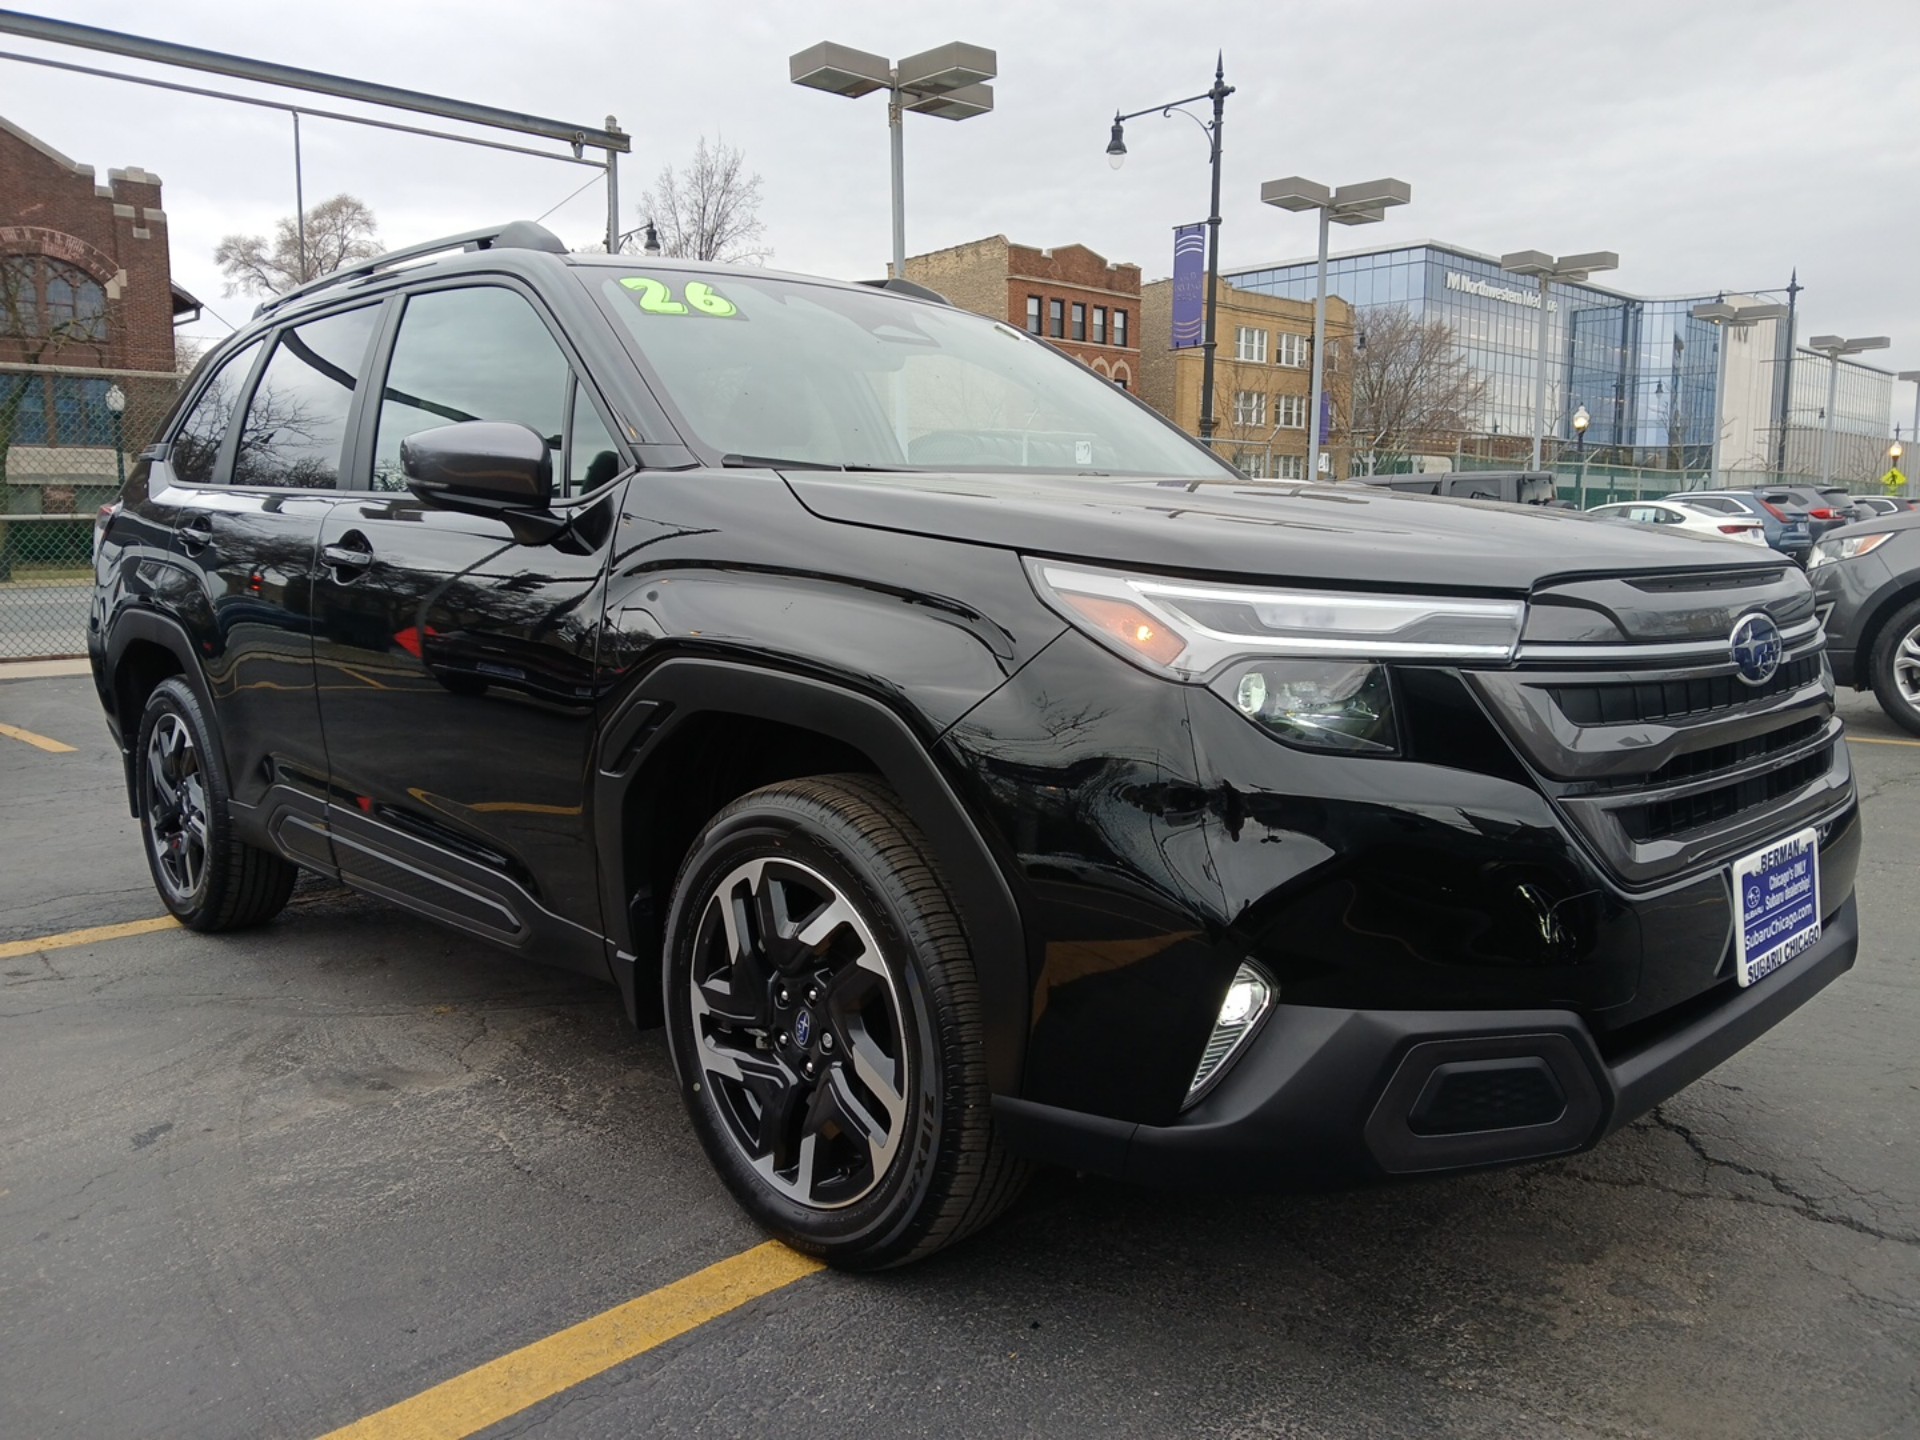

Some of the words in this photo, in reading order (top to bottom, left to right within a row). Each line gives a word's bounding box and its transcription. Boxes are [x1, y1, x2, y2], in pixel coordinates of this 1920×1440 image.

[619, 277, 737, 317] 26
[1461, 273, 1522, 305] Northwestern
[1523, 289, 1558, 312] Medne
[1760, 839, 1801, 871] BERMAN
[1769, 867, 1794, 890] Chicago's
[1744, 906, 1765, 922] SUBARU
[1765, 893, 1785, 911] Subaru
[1745, 903, 1812, 950] SubaruChicago.com
[1747, 950, 1782, 984] SUBARU
[1784, 926, 1819, 961] CHICAGO
